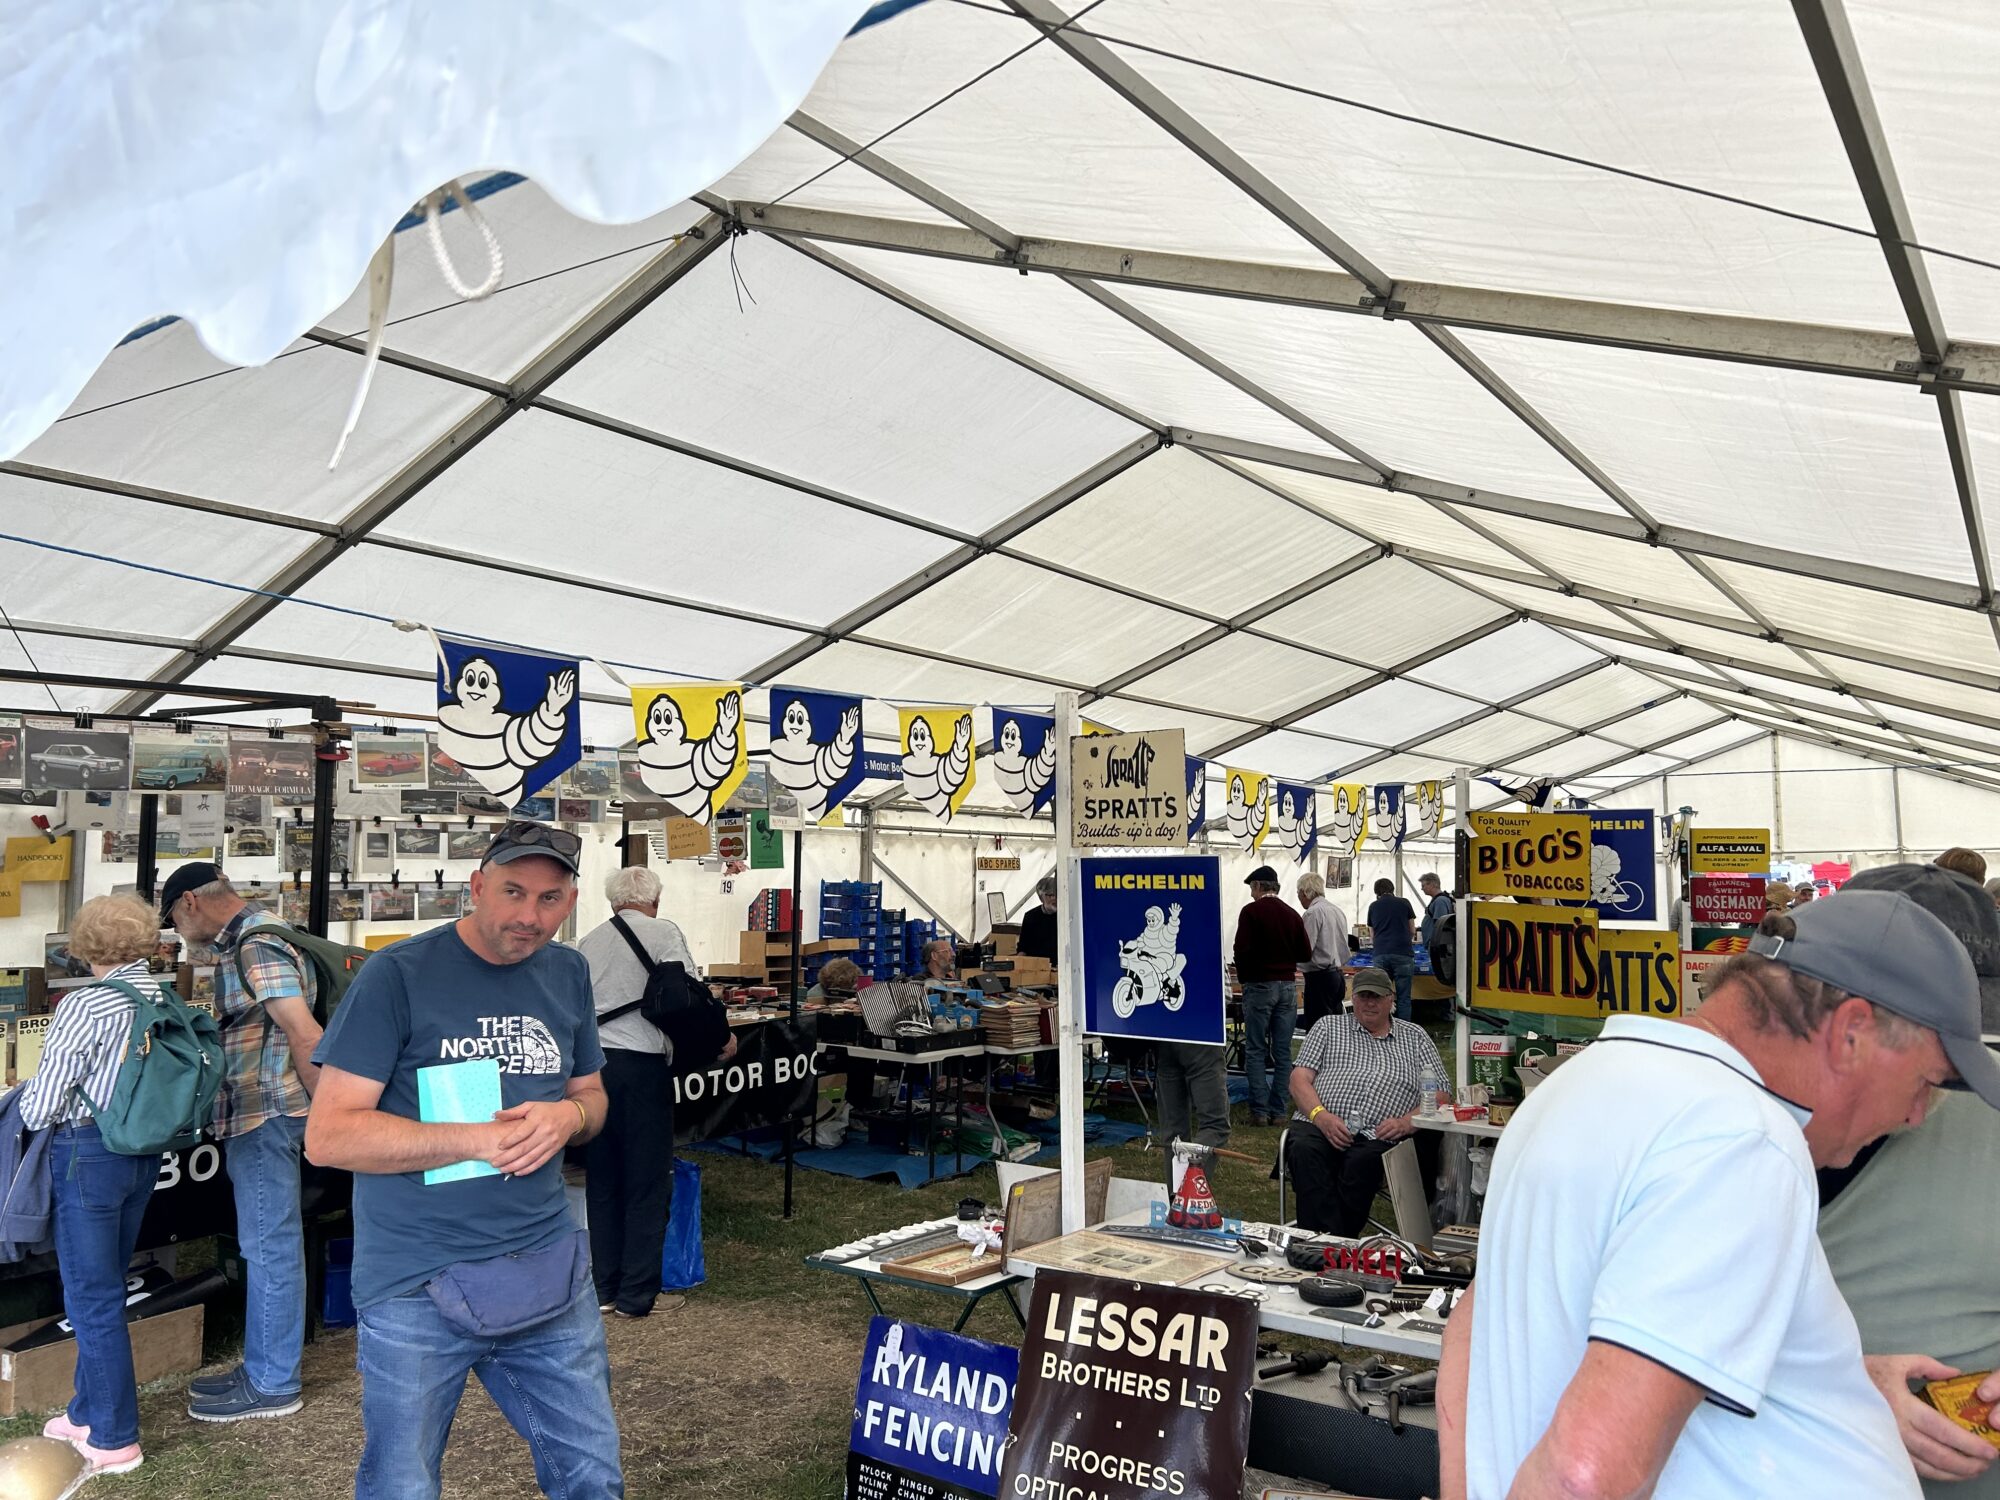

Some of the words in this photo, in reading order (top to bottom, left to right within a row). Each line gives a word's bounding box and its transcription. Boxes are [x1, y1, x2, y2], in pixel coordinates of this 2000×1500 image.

[869, 760, 889, 772] Motor
[230, 785, 247, 793] THE
[249, 785, 273, 794] MAGIC
[274, 785, 311, 794] FORMULA
[1144, 827, 1152, 838] a
[1154, 822, 1181, 841] dog!
[17, 854, 63, 862] HANDBOOKS
[1477, 828, 1584, 875] BIGG'S
[980, 859, 993, 868] ABC
[995, 859, 1020, 869] SPARES
[722, 880, 732, 893] 19
[1094, 874, 1205, 890] MICHELIN
[1503, 873, 1585, 892] TOBACCOS
[1695, 895, 1764, 909] ROSEMARY
[1706, 911, 1752, 920] TOBACCO
[1476, 916, 1598, 999] PRATT'S
[19, 1017, 54, 1030] BRO
[477, 1016, 520, 1037] THE
[440, 1037, 523, 1059] NORTH
[1472, 1041, 1502, 1051] Castrol
[1044, 1292, 1228, 1372] LESSAR
[872, 1345, 1017, 1415] RYLAND
[1041, 1351, 1171, 1402] BROTHERS
[1049, 1441, 1185, 1496] PROGRESS
[858, 1474, 889, 1492] RYLINK
[860, 1463, 893, 1482] RYLOCK
[899, 1476, 934, 1496] HINGED
[1014, 1473, 1111, 1500] OPTIC
[857, 1485, 883, 1500] RYNET
